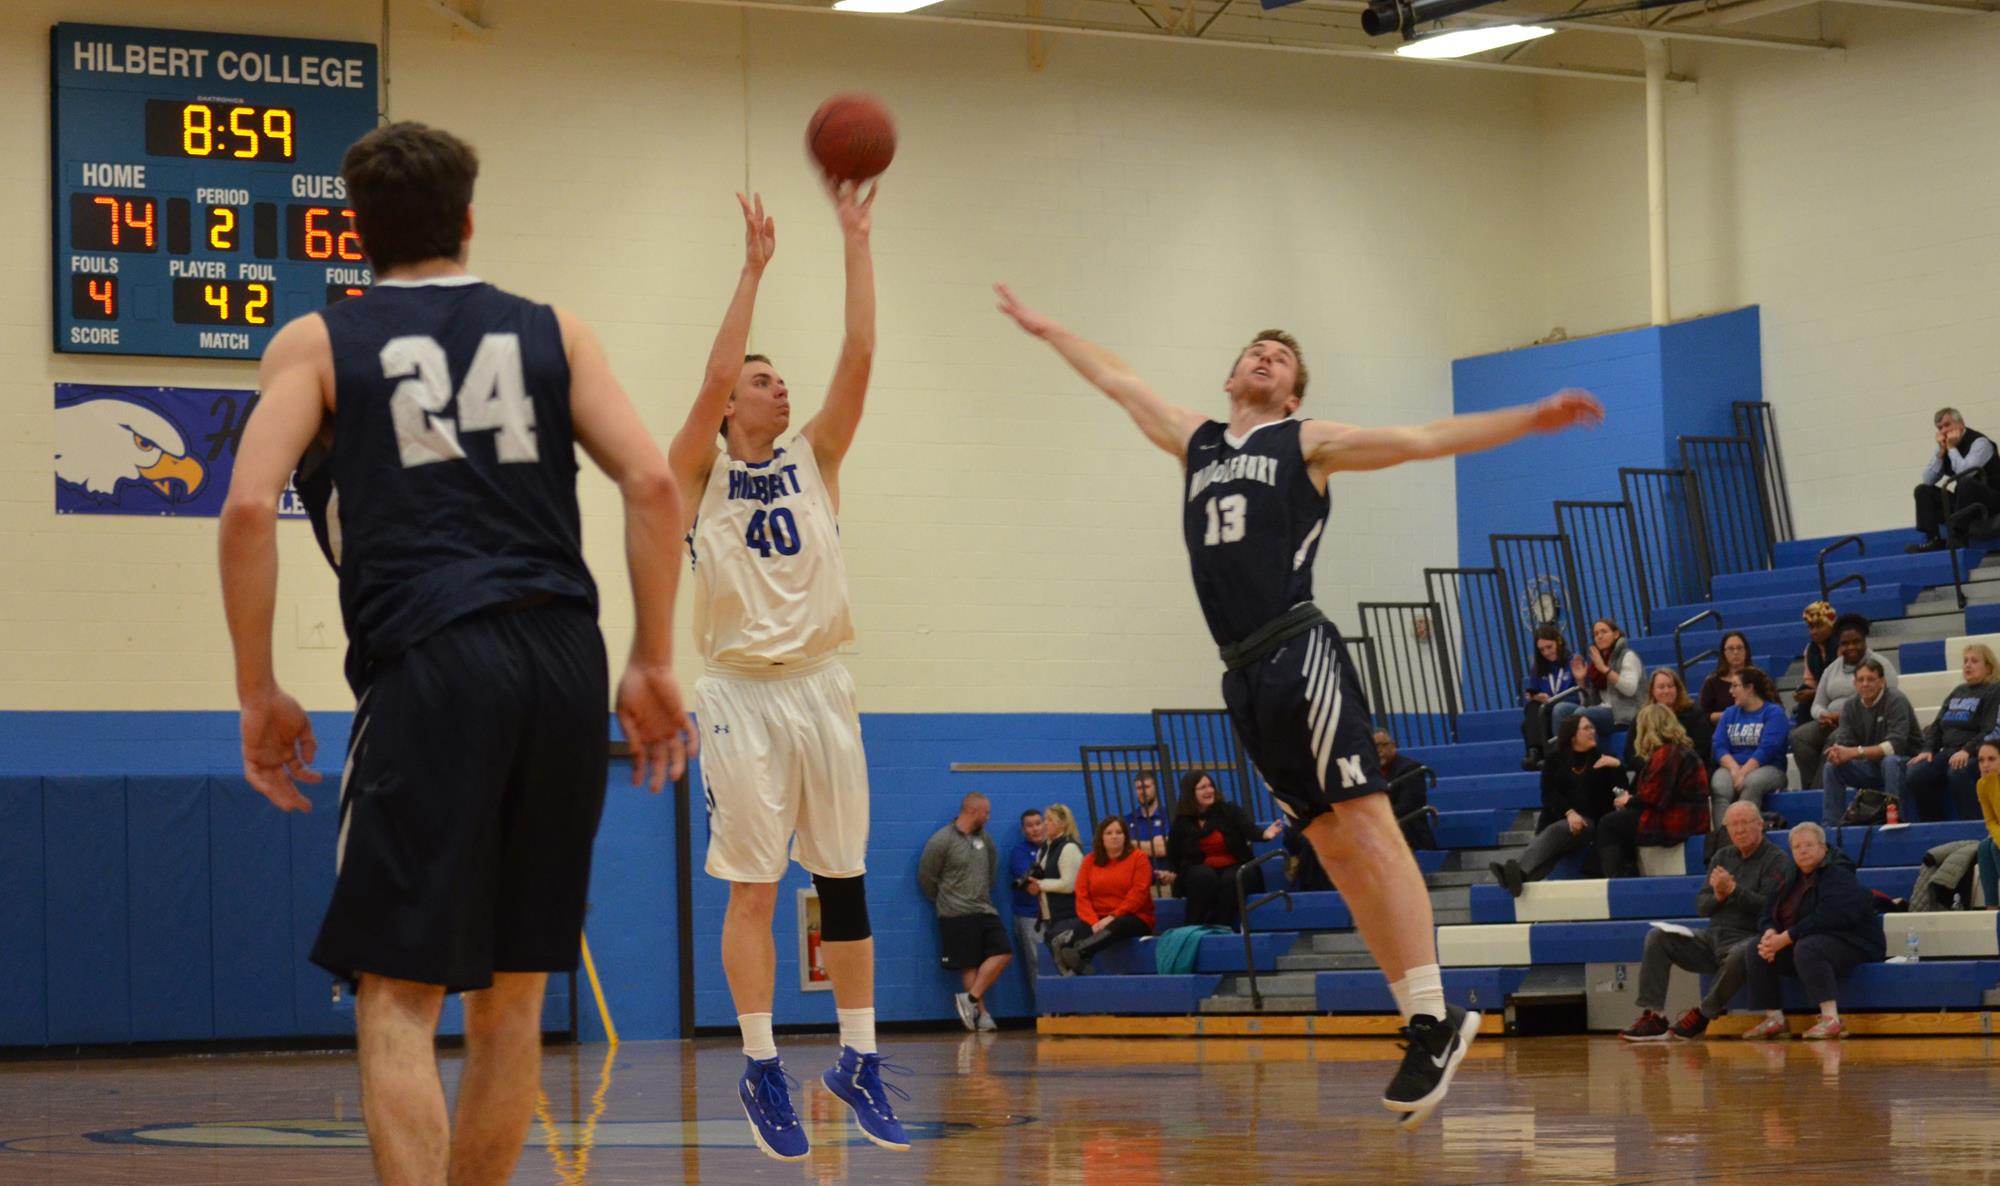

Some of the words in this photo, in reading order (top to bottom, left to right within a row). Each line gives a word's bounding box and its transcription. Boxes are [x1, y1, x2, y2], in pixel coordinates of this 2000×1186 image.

[73, 41, 208, 78] HILBERT
[217, 51, 364, 88] COLLEGE
[183, 104, 292, 159] 8:59
[83, 163, 146, 188] HOME
[291, 174, 347, 200] GUES
[196, 188, 249, 205] PERIOD
[94, 197, 155, 247] 74
[210, 208, 234, 249] 2
[304, 207, 363, 260] 62
[71, 256, 118, 274] FOULS
[169, 260, 226, 279] PLAYER
[239, 263, 276, 282] FOUL
[326, 267, 372, 285] FOULS
[88, 280, 113, 315] 4
[71, 327, 119, 345] SCORE
[199, 332, 249, 350] MATCH
[378, 331, 540, 468] 24
[745, 507, 801, 558] 40
[1204, 493, 1248, 546] 13
[1336, 754, 1368, 789] M
